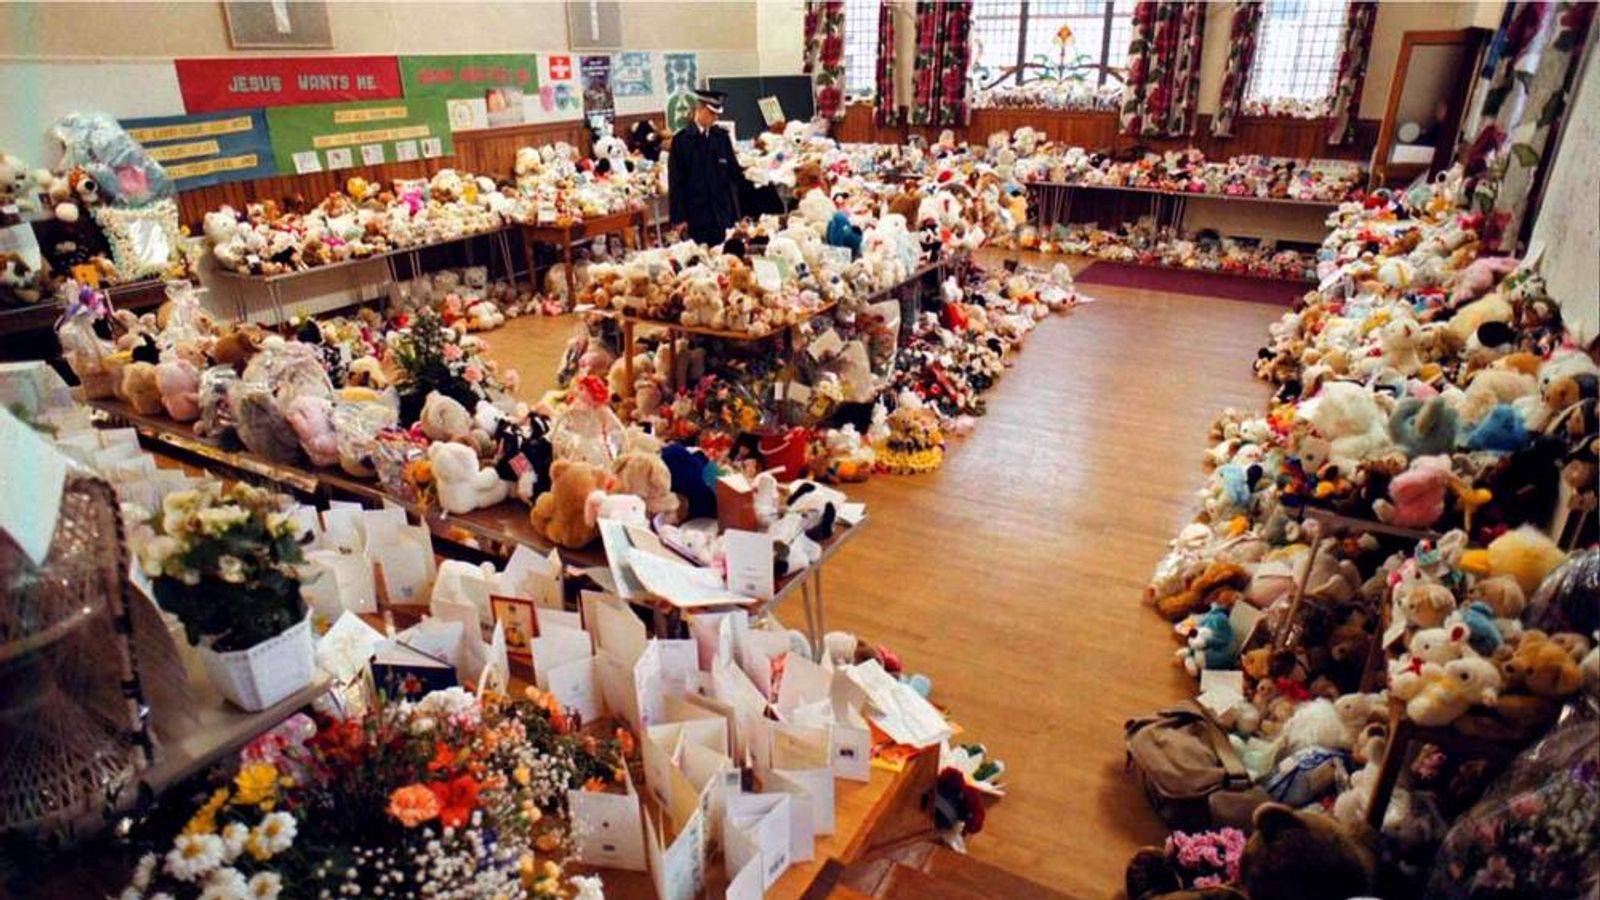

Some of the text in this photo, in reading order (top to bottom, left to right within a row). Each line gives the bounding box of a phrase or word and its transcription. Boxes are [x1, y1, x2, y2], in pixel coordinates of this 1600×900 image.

[228, 74, 378, 93] JESUS WANTS ME
